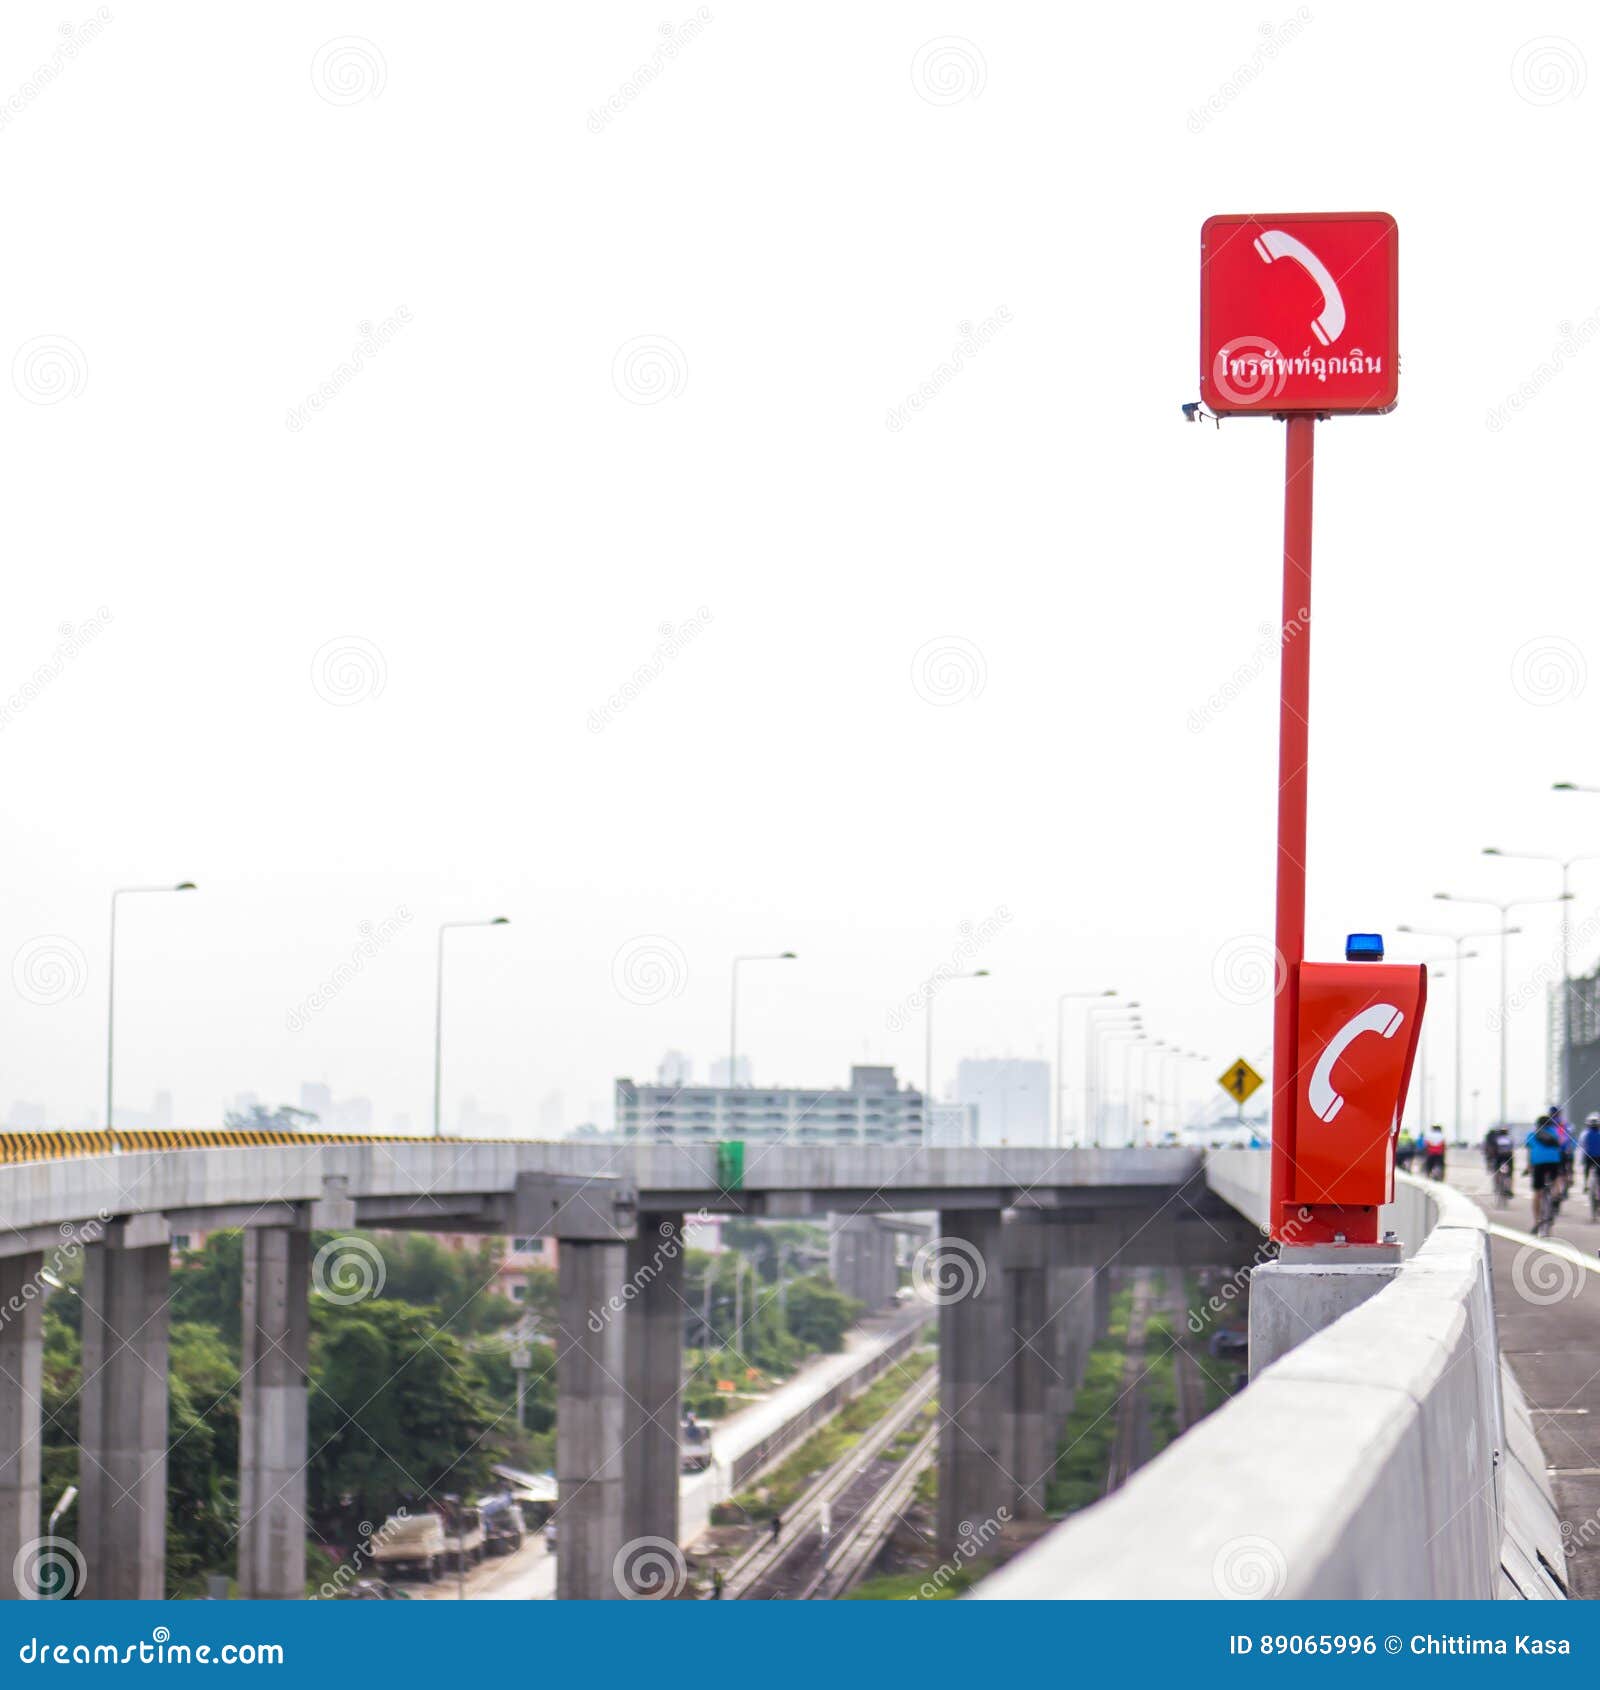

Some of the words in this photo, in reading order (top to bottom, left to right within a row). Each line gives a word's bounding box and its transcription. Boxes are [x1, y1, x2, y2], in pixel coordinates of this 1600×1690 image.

[1219, 347, 1382, 382] โทรศัพท์ฉุกเฉิน
